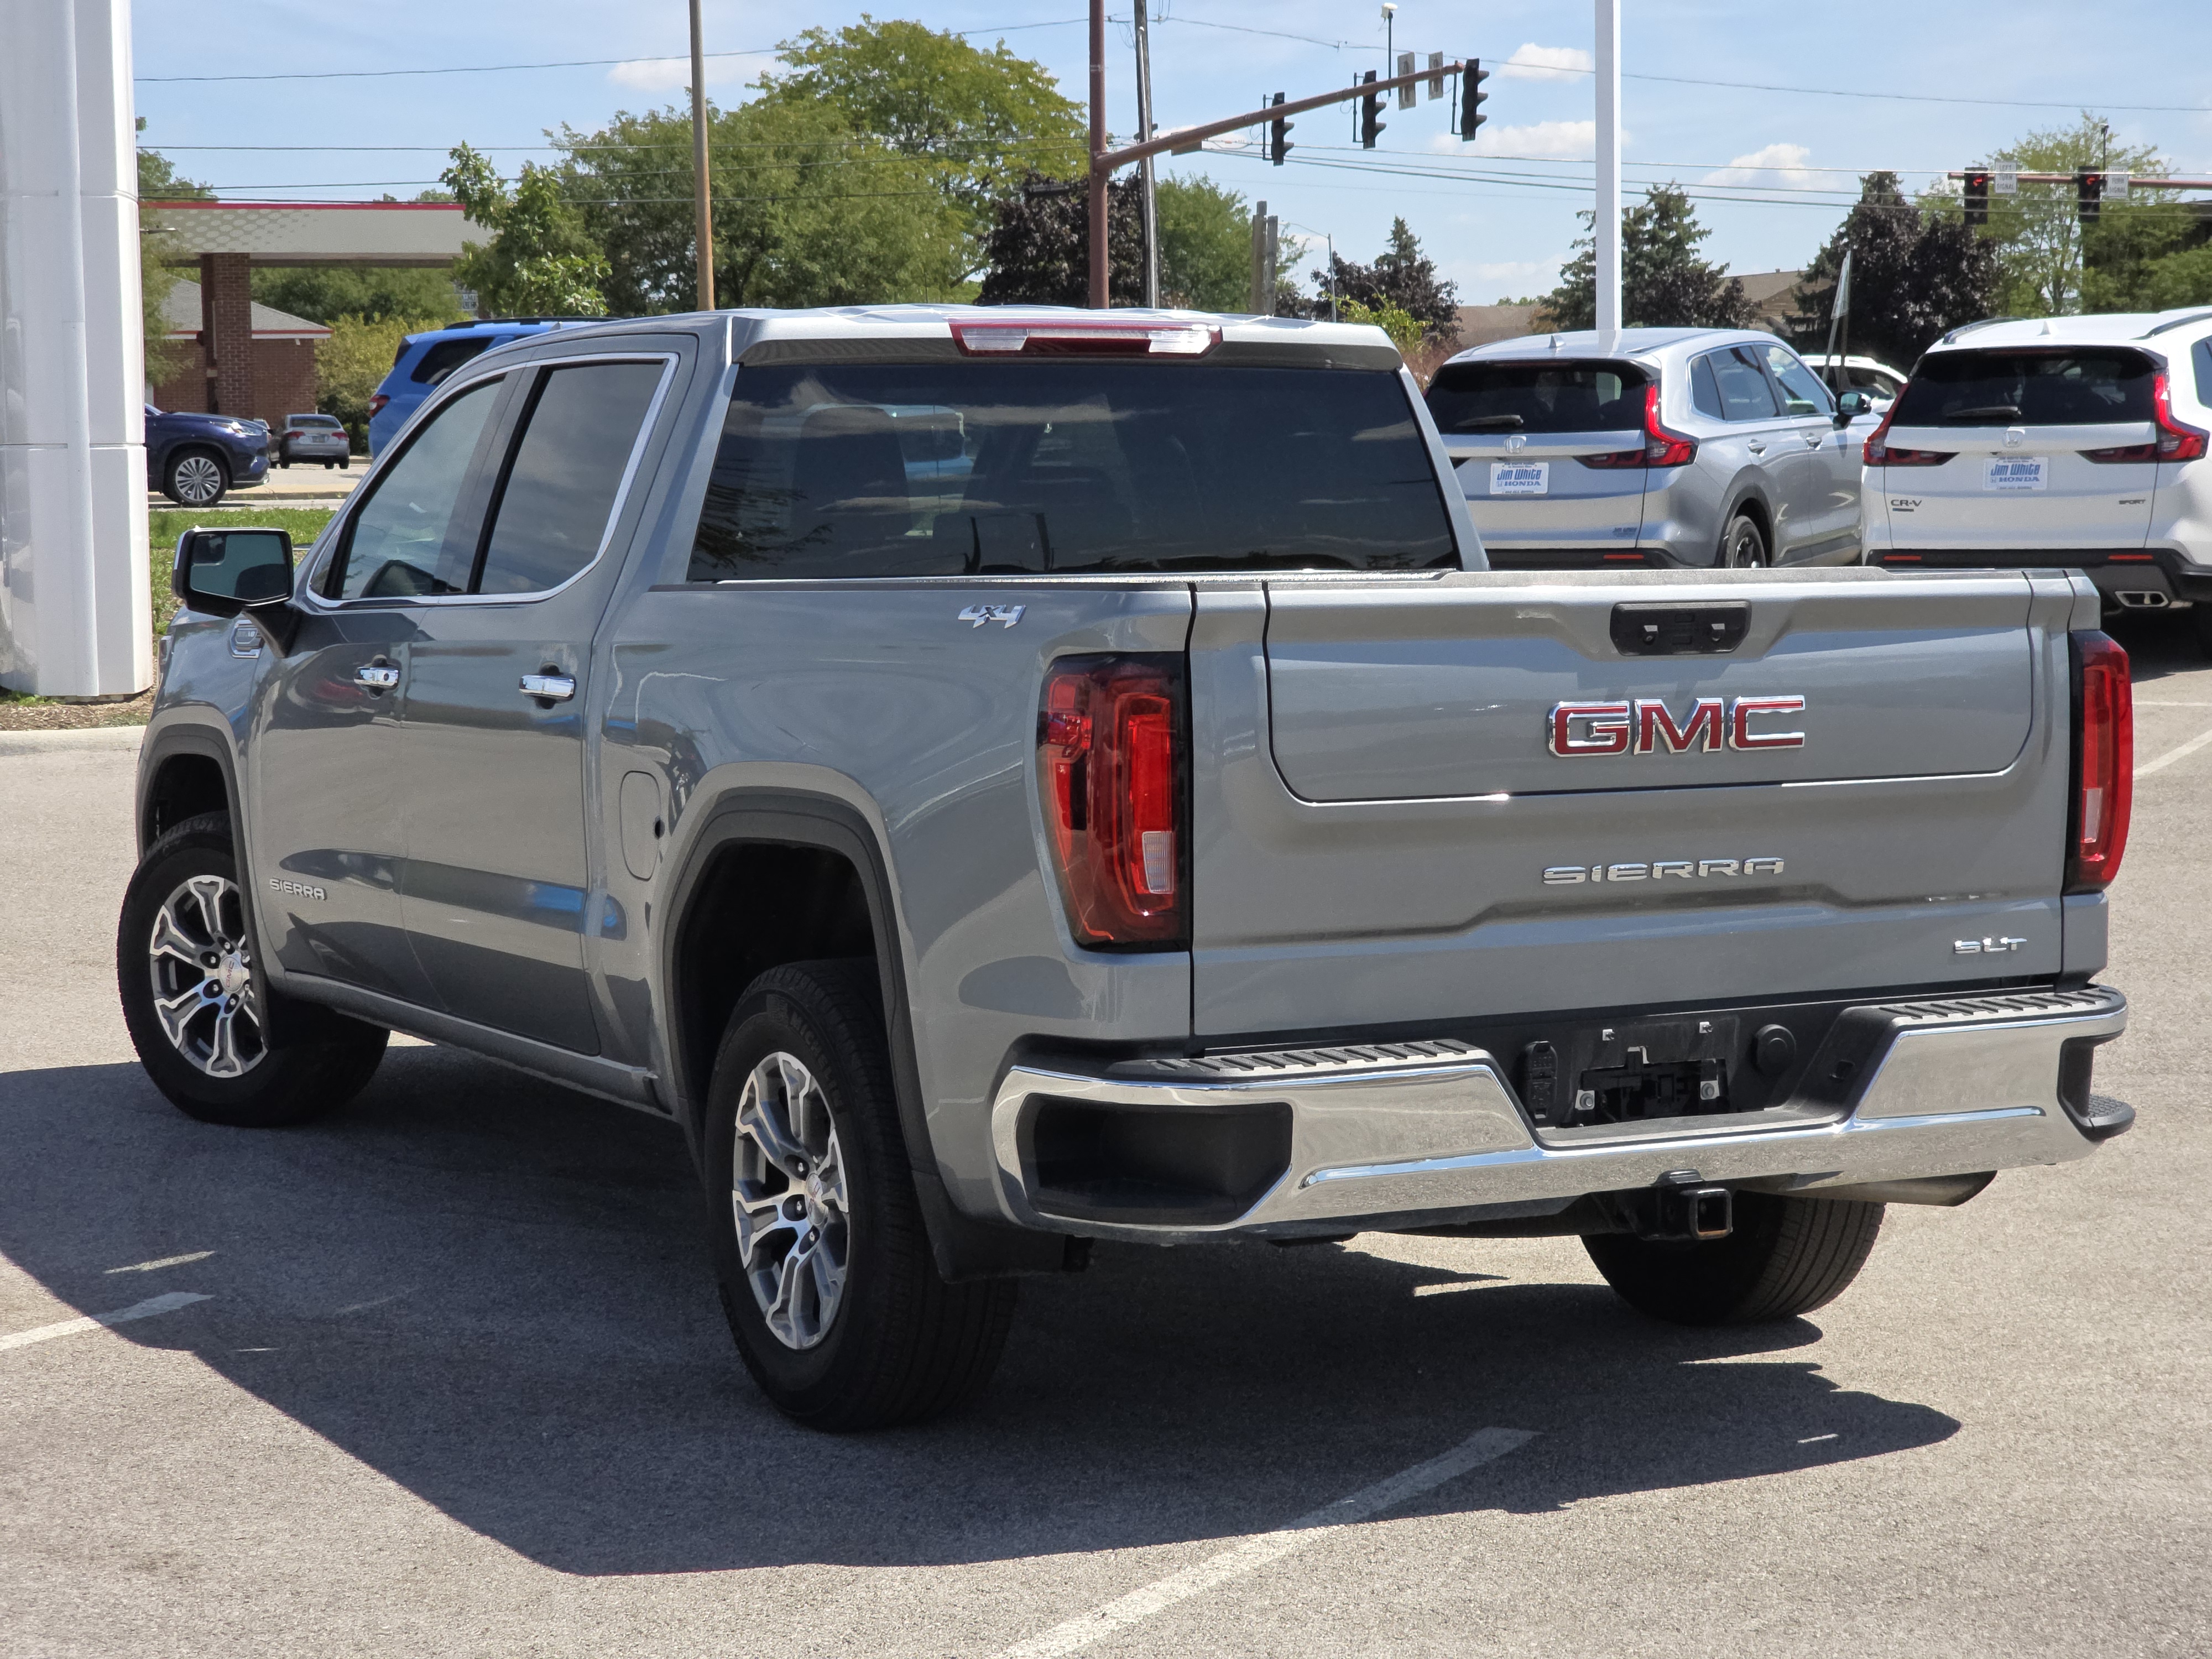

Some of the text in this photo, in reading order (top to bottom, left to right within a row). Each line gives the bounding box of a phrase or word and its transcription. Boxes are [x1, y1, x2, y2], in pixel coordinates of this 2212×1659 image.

[1497, 468, 1542, 481] Jim White
[1990, 464, 2010, 476] Jim
[1547, 694, 1806, 758] GMC
[1542, 856, 1785, 885] SIERRA
[269, 878, 327, 901] SIERRA
[1954, 936, 2028, 954] SLT
[225, 959, 235, 988] GMC
